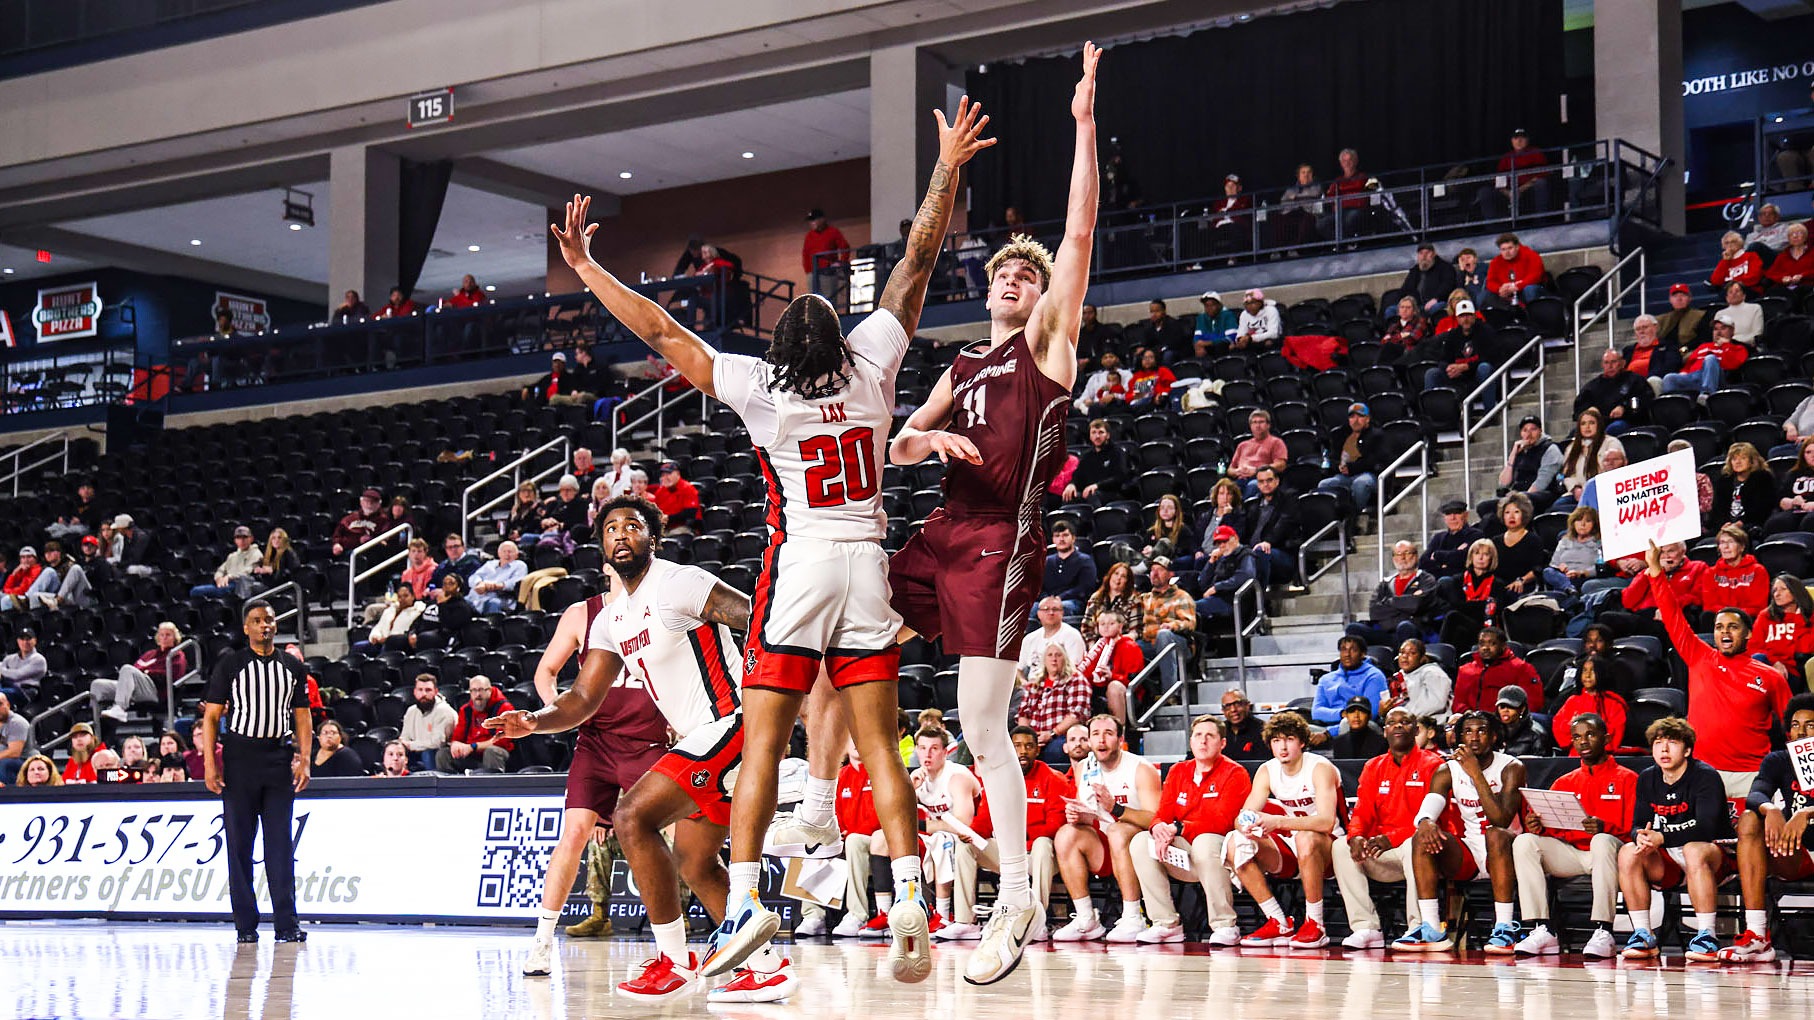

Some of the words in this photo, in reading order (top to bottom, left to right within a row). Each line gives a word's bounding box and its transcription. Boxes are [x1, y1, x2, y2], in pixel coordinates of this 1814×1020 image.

[1730, 69, 1769, 89] LIKE
[1772, 64, 1799, 82] NO
[417, 97, 443, 119] 115
[50, 317, 83, 333] PIZZA
[819, 402, 848, 423] LAX
[962, 384, 988, 429] 11
[798, 426, 878, 508] 20
[1615, 469, 1669, 496] DEFEND
[1616, 494, 1630, 506] NO
[1631, 483, 1670, 502] MATTER
[1618, 492, 1674, 525] WHAT
[637, 657, 659, 701] 1
[1794, 741, 1814, 755] DE
[12, 811, 311, 865] 931-557-31
[0, 870, 91, 900] rtners
[98, 866, 133, 912] of
[131, 868, 214, 902] APSU
